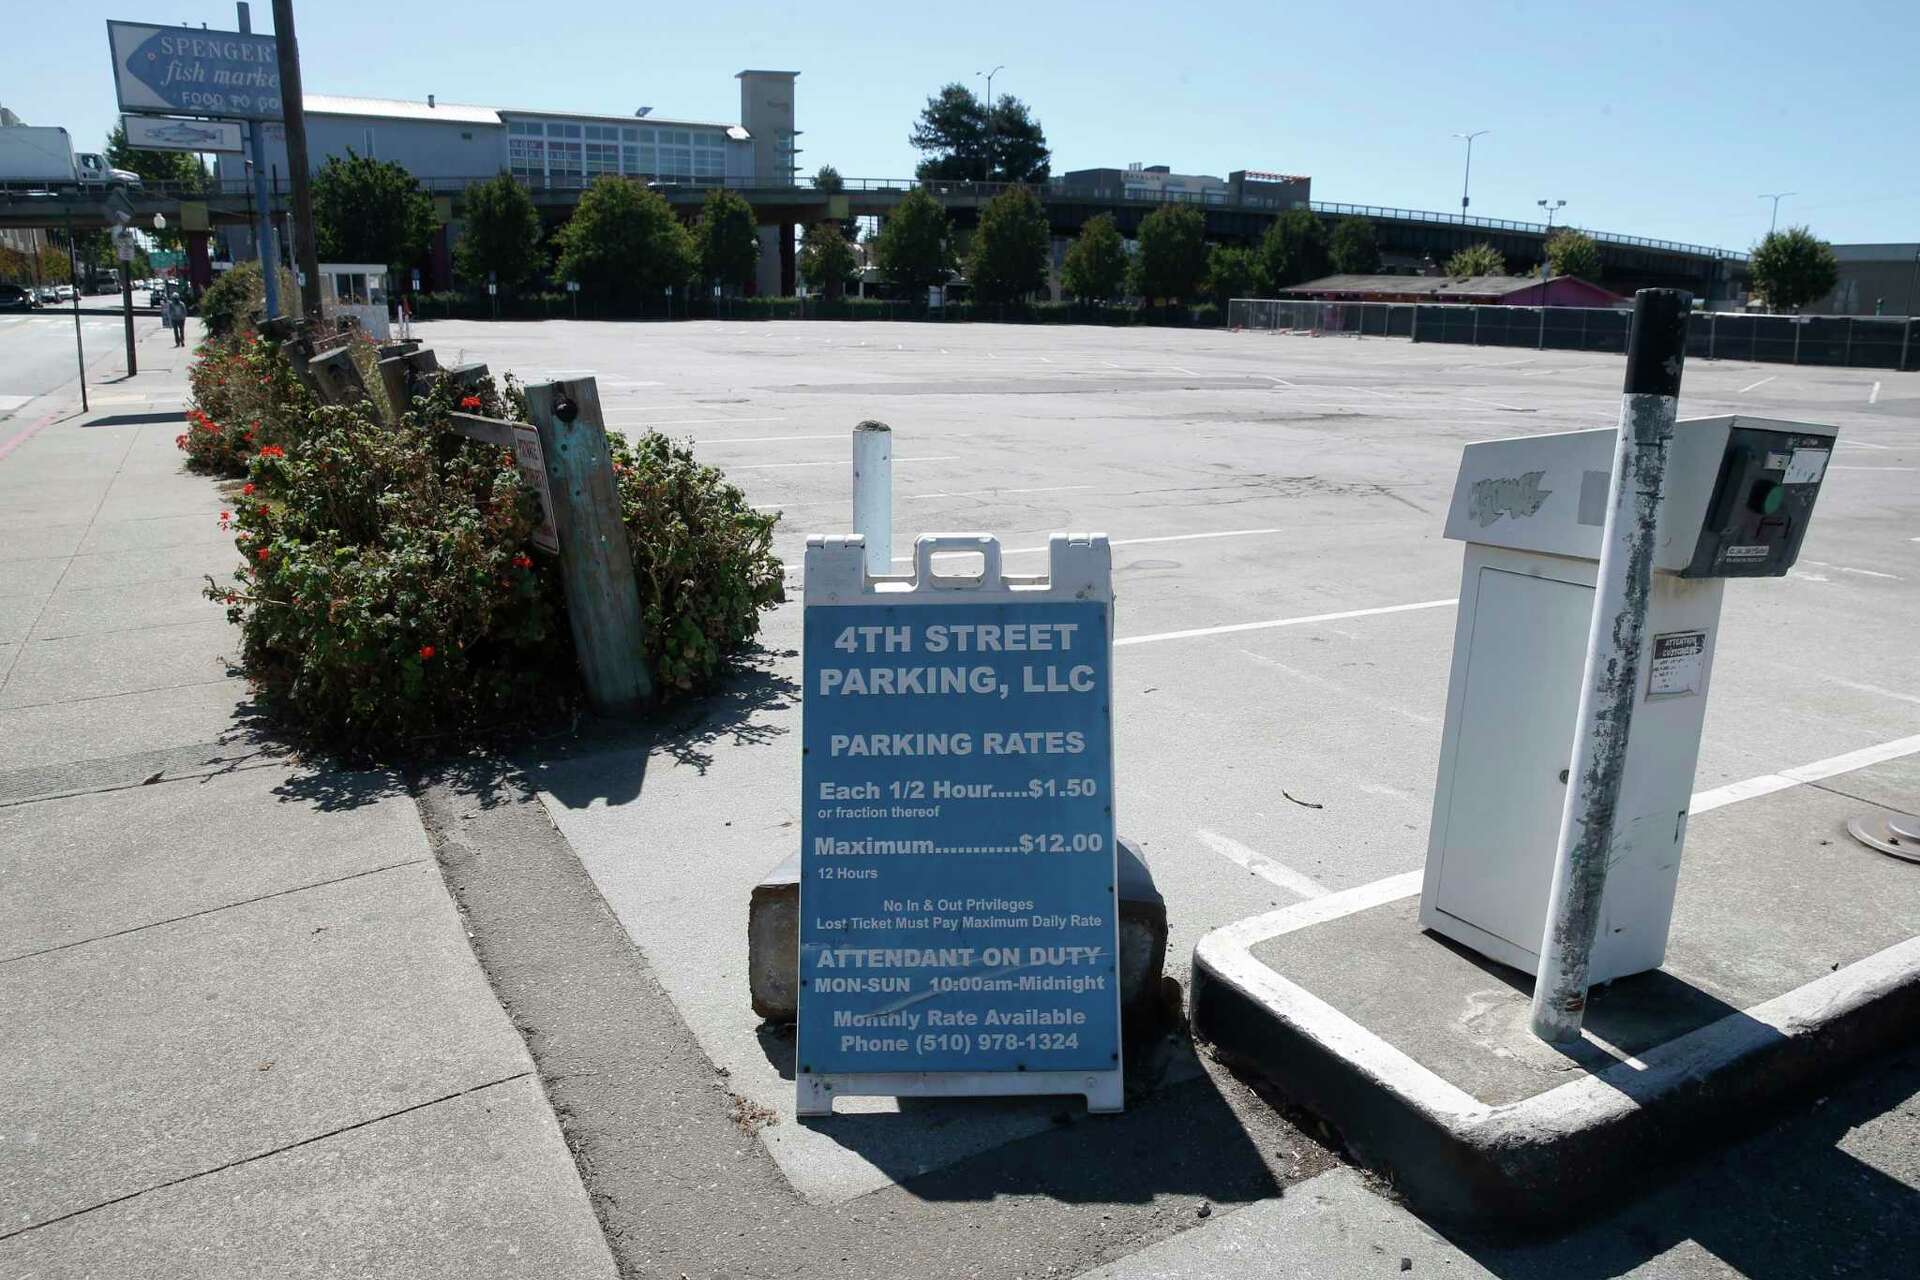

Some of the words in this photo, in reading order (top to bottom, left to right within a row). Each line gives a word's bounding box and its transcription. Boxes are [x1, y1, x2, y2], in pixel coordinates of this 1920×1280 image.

[160, 36, 277, 63] SPENGER'
[160, 59, 205, 86] fish
[214, 67, 280, 88] marke
[182, 91, 224, 106] FOOD
[231, 94, 251, 107] TO
[258, 97, 279, 109] GO
[835, 626, 911, 653] 4TH
[925, 624, 1078, 652] STREET
[820, 667, 1008, 699] PARKING,
[1024, 665, 1095, 692] LLC
[832, 733, 971, 756] PARKING
[984, 732, 1085, 754] RATES
[820, 782, 880, 799] Each
[890, 781, 924, 799] 1/2
[818, 810, 832, 818] or
[836, 807, 887, 818] fraction
[892, 806, 940, 817] thereof
[818, 868, 833, 879] 12
[838, 868, 878, 878] Hours
[884, 900, 902, 911] No
[907, 900, 919, 911] In
[924, 900, 933, 911] &
[938, 899, 962, 911] Out
[967, 899, 1033, 913] Privileges
[817, 918, 846, 929] Lost
[851, 918, 891, 929] Ticket
[896, 917, 928, 928] Must
[933, 917, 958, 931] Pay
[963, 916, 1028, 928] Maximum
[1033, 915, 1066, 929] Daily
[1071, 915, 1102, 926] Rate
[817, 948, 974, 967] ATTENDANT
[983, 948, 1020, 966] ON
[1030, 947, 1101, 966] DUTY
[815, 978, 910, 992] MON-SUN
[834, 1011, 920, 1029] Monthly
[928, 1010, 977, 1025] Rate
[985, 1008, 1086, 1025] Available
[841, 1036, 909, 1051] Phone
[917, 1034, 970, 1054] (510)
[978, 1033, 1078, 1050] 978-1324
